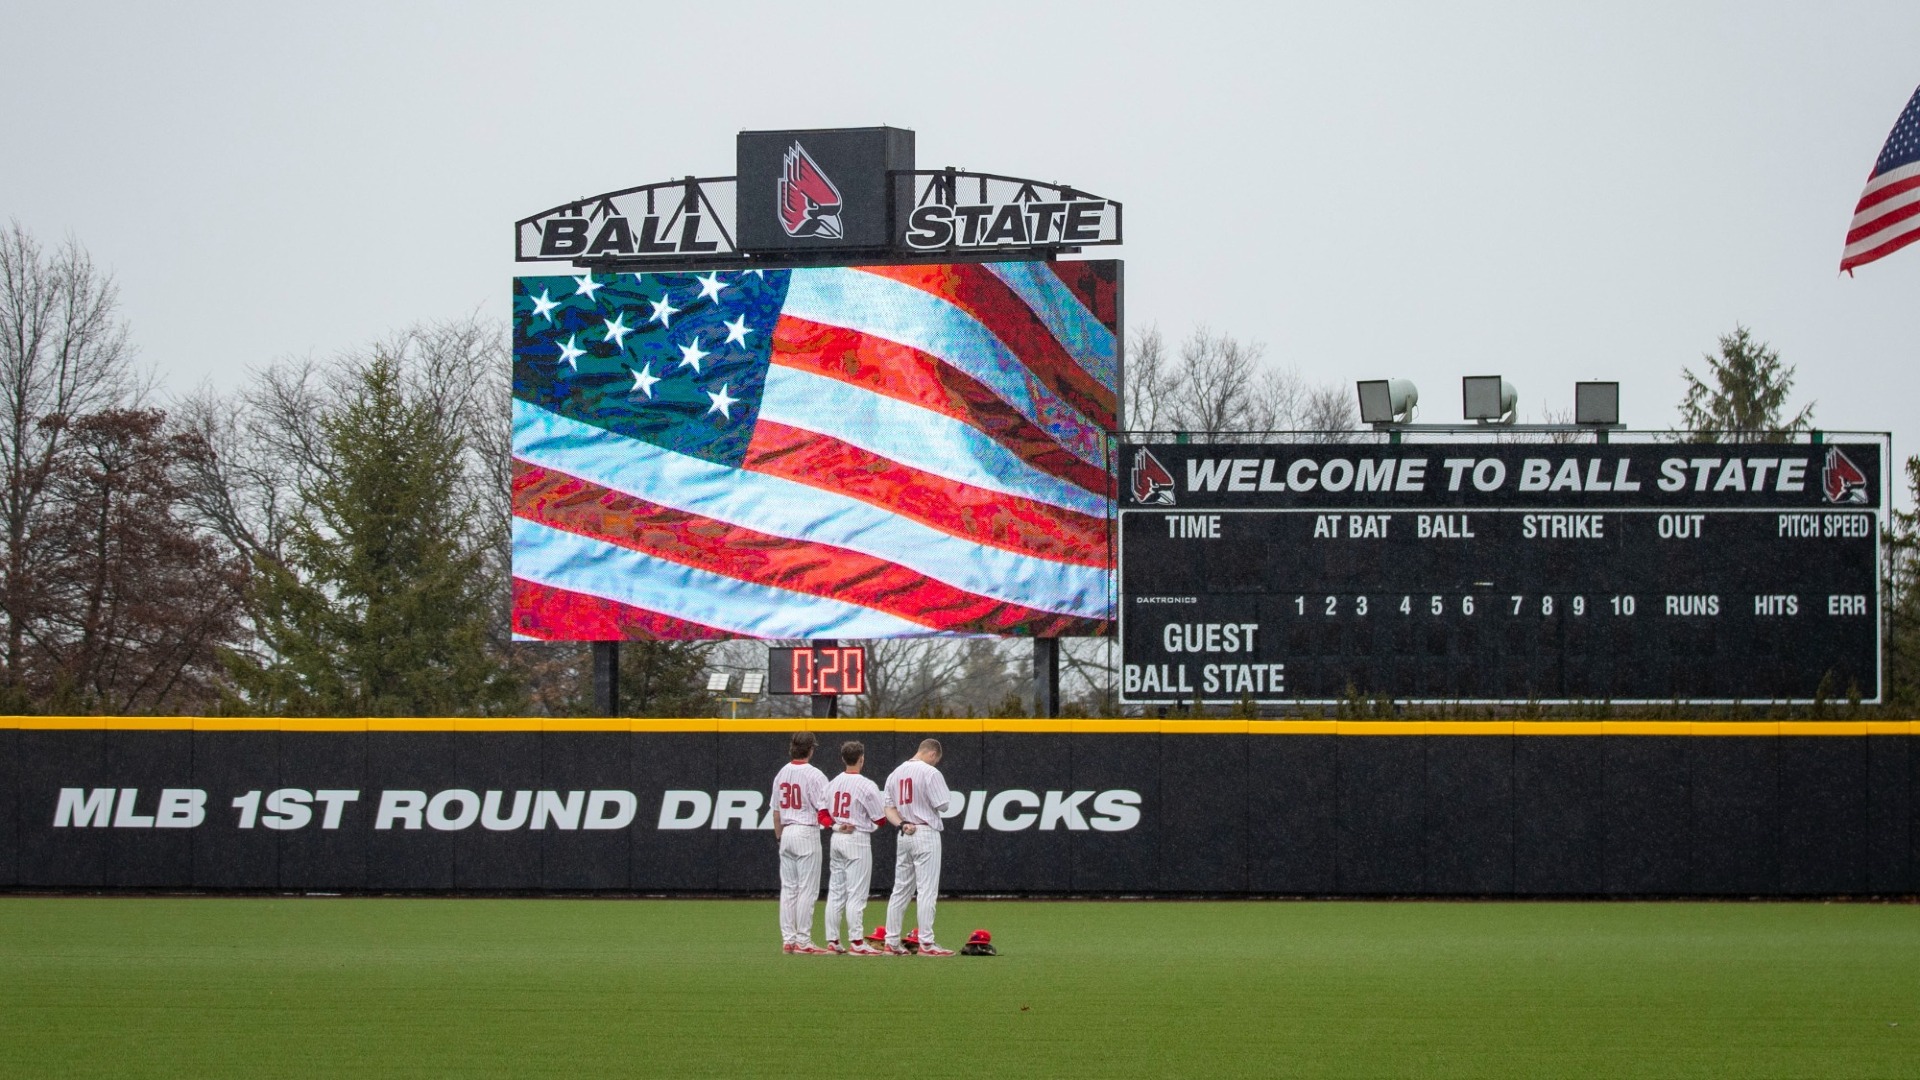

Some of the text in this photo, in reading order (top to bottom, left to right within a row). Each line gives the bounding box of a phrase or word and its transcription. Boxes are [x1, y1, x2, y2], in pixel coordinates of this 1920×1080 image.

[537, 201, 1108, 256] BALL STATE
[1186, 458, 1809, 492] WELCOME TO BALL STATE
[1165, 515, 1221, 538] TIME
[1313, 515, 1392, 538] AT BAT
[1417, 515, 1475, 538] BALL
[1522, 515, 1604, 539] STRIKE
[1658, 515, 1705, 539] OUT
[1778, 515, 1869, 538] PITCH SPEED
[1295, 595, 1866, 616] 1 2 3 4 5 6 7 8 9 10 RUNS HITS ERR
[1163, 623, 1258, 652] GUEST
[1124, 664, 1284, 692] BALL STATE
[779, 782, 802, 809] 30
[833, 791, 851, 818] 12
[899, 777, 913, 805] 10
[53, 788, 207, 828] MLB
[231, 788, 360, 830] 1ST
[375, 789, 637, 830] ROUND
